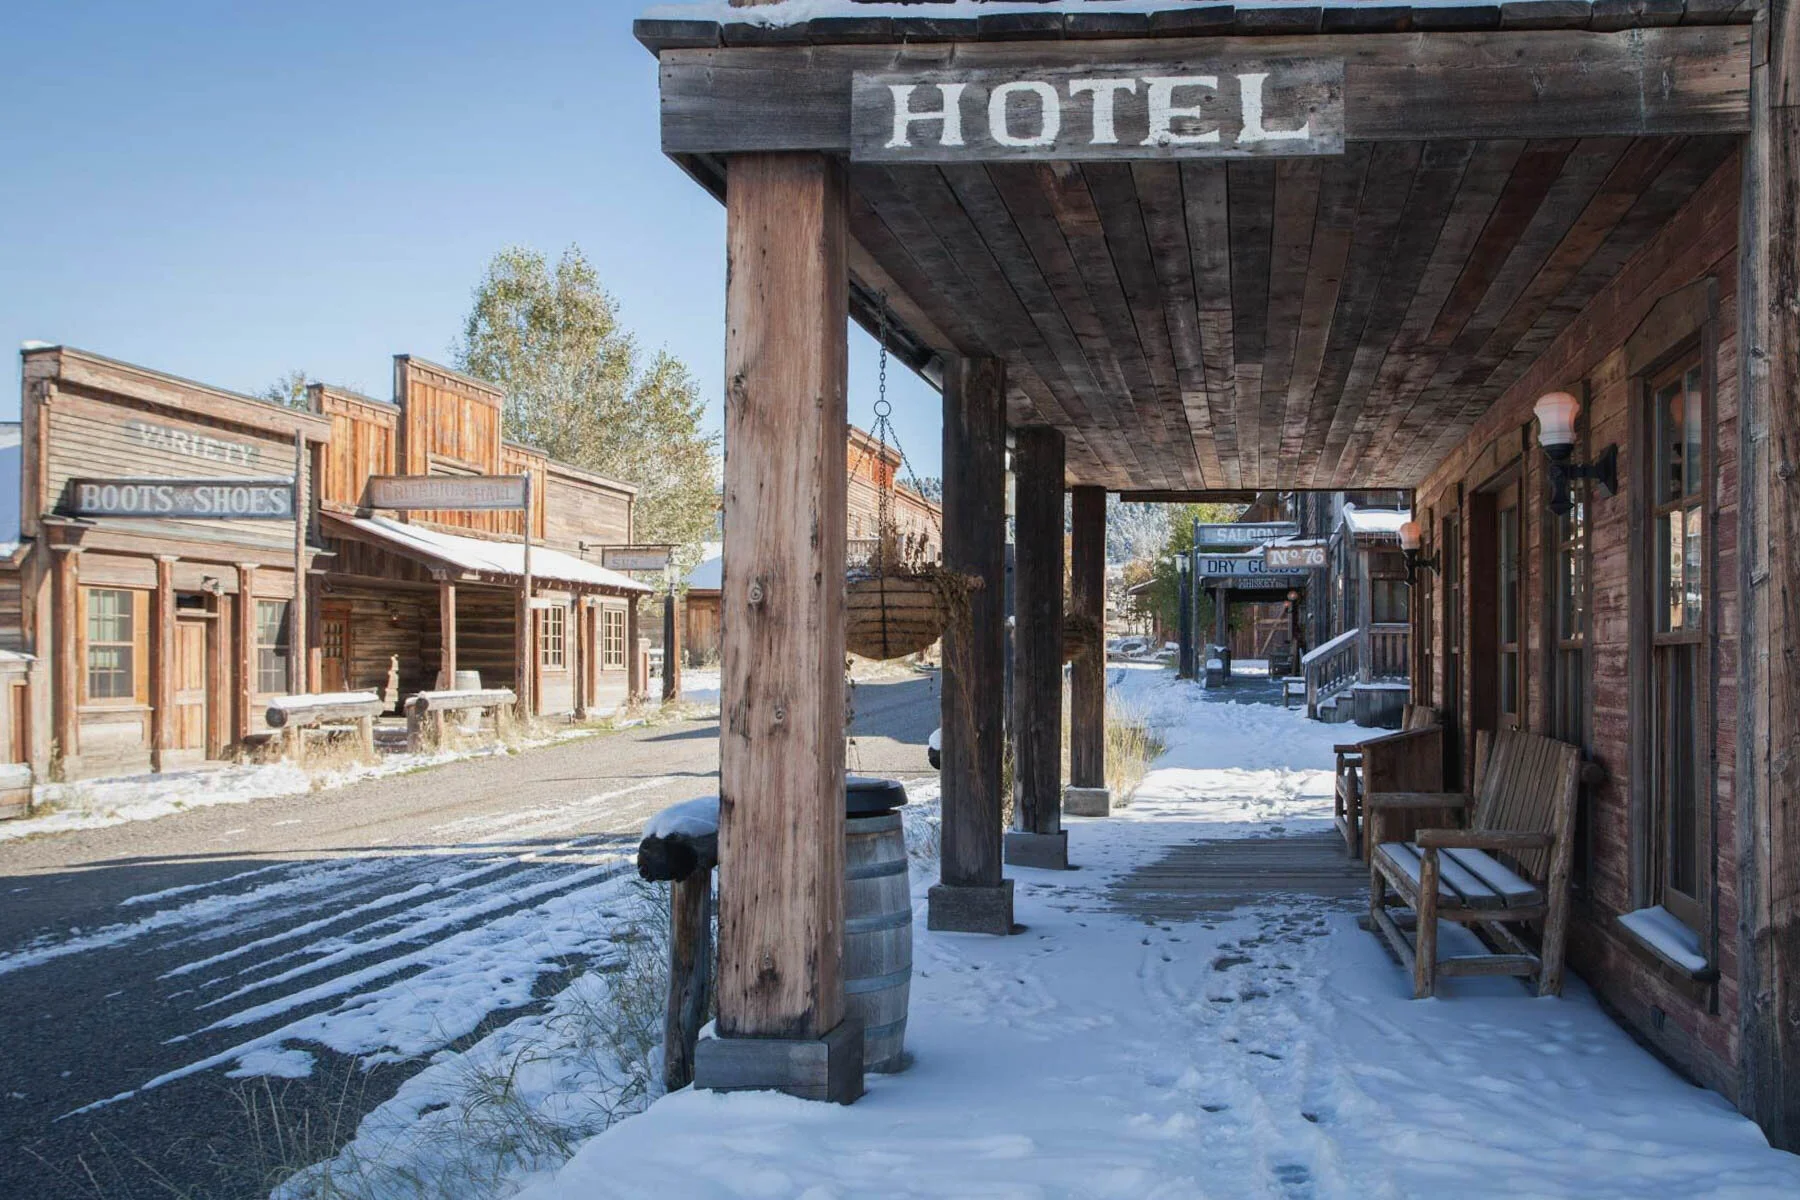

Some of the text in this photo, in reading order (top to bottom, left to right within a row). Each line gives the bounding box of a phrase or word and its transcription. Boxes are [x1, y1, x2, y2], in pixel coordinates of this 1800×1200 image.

[883, 72, 1310, 148] HOTEL
[139, 424, 253, 466] VARIETY
[79, 484, 174, 512] BOOTS
[193, 486, 288, 514] SHOES
[473, 484, 515, 502] HALL
[1216, 528, 1278, 542] SALOON
[1302, 548, 1324, 564] 76
[1207, 560, 1237, 573] DRY
